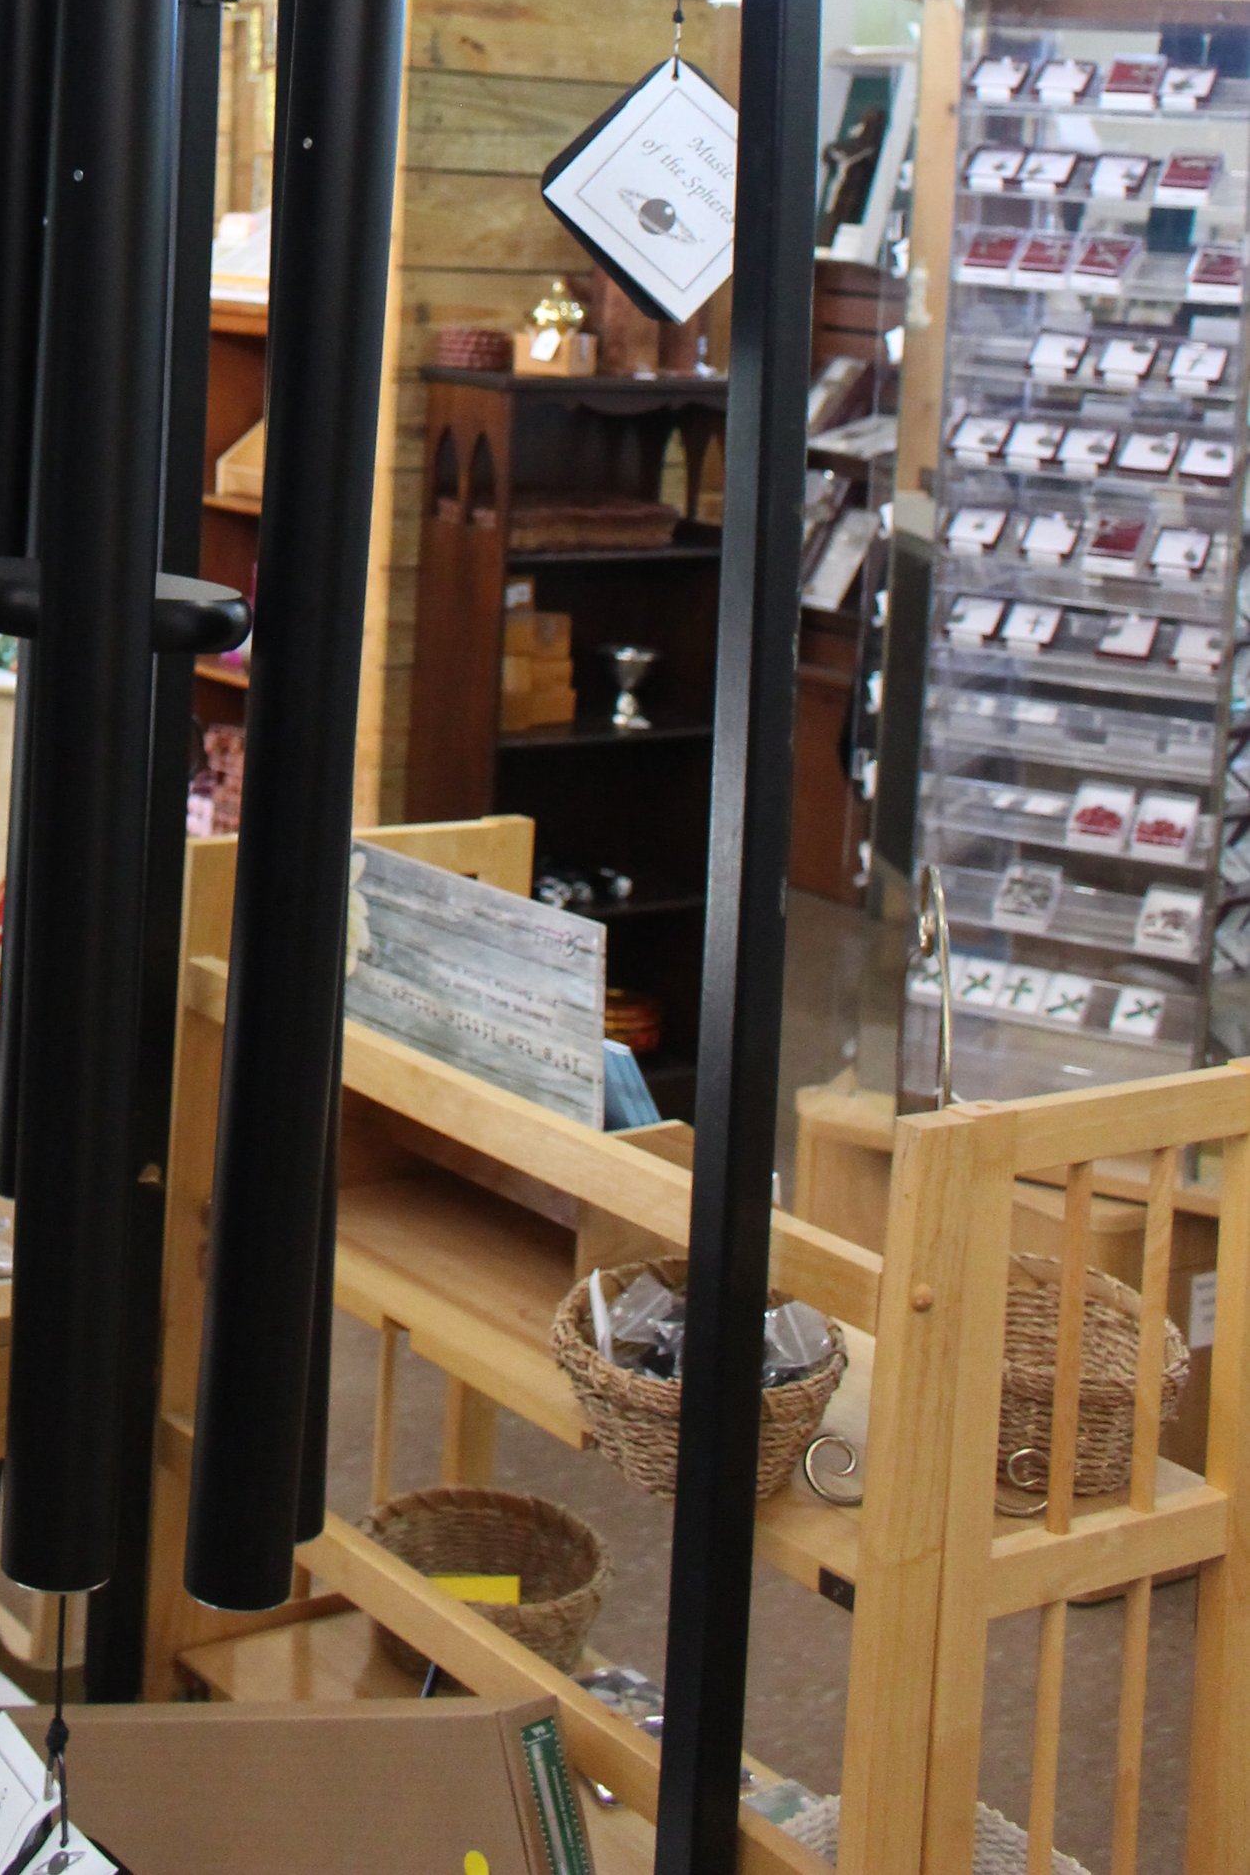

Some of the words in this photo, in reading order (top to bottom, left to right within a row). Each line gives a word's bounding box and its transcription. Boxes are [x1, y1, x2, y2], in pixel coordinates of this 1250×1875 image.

[641, 139, 668, 156] of
[660, 154, 685, 177] the
[687, 137, 734, 180] Music
